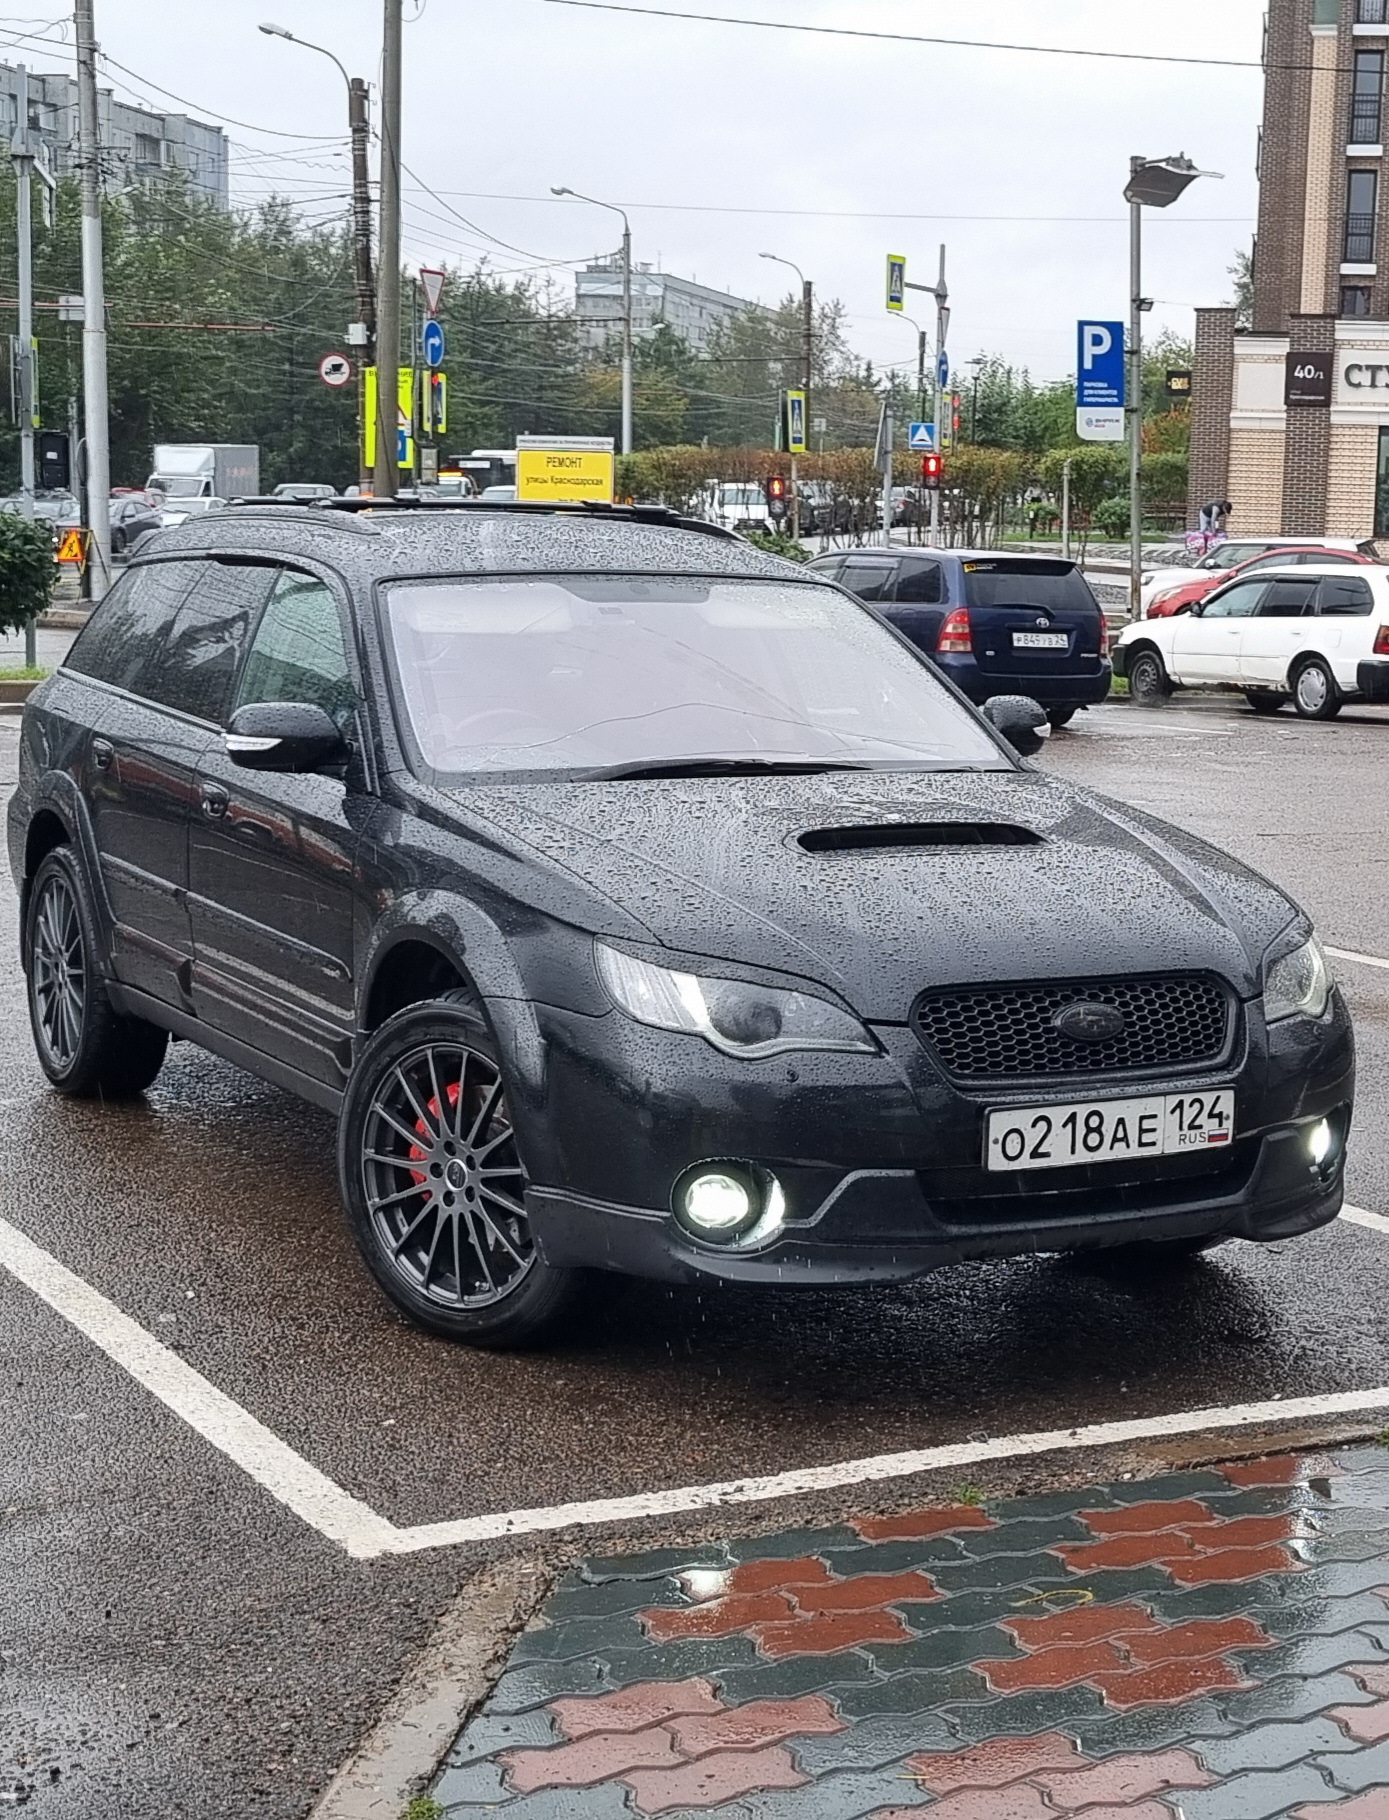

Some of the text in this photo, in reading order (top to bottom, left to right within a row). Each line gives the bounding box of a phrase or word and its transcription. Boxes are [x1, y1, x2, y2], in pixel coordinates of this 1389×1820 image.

[1083, 325, 1112, 370] P
[1294, 364, 1324, 379] 40/1
[546, 456, 583, 468] РЕМОНТ
[1001, 1095, 1224, 1162] О218АЕ 124
[1179, 1131, 1207, 1146] RUS
